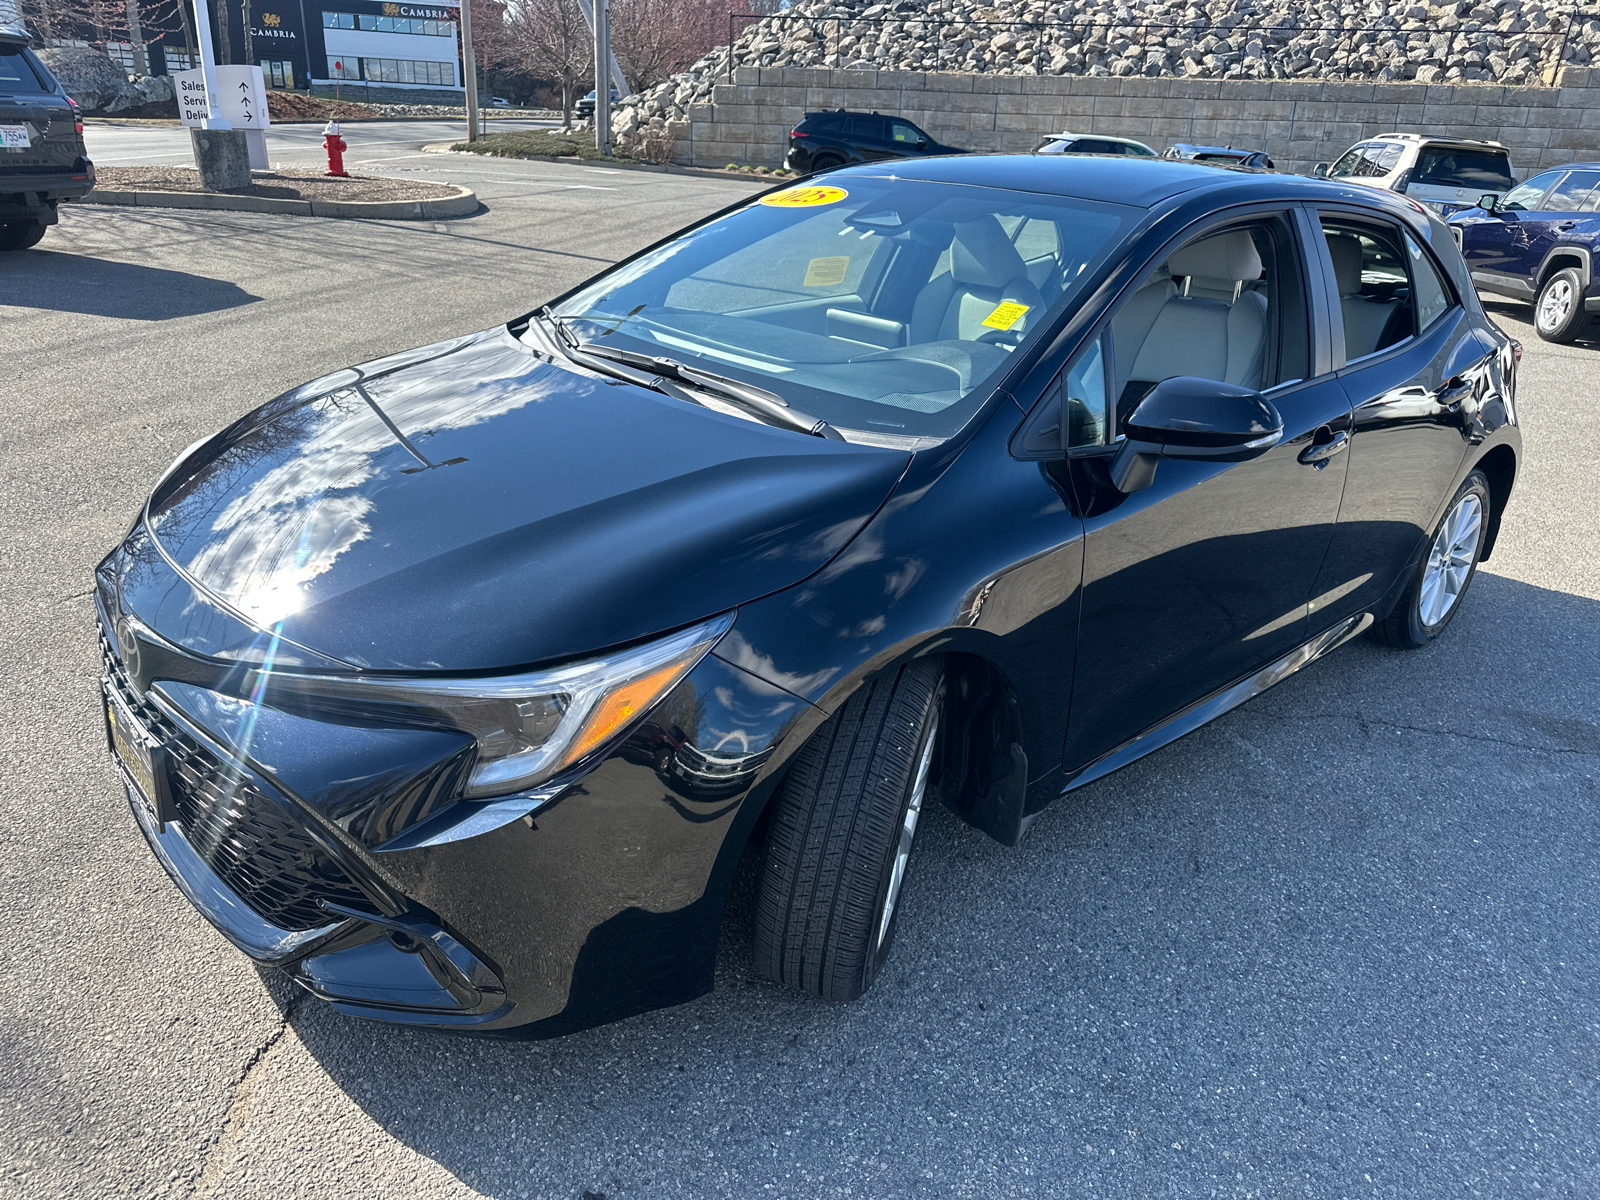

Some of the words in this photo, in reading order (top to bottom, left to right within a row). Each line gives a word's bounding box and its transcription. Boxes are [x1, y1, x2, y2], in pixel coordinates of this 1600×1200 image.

[400, 6, 449, 19] CAMBRIA
[250, 27, 296, 39] CAMBRIA
[181, 81, 206, 92] Sales
[183, 95, 206, 106] Servi
[186, 110, 209, 120] Deliv
[765, 189, 839, 203] 2025
